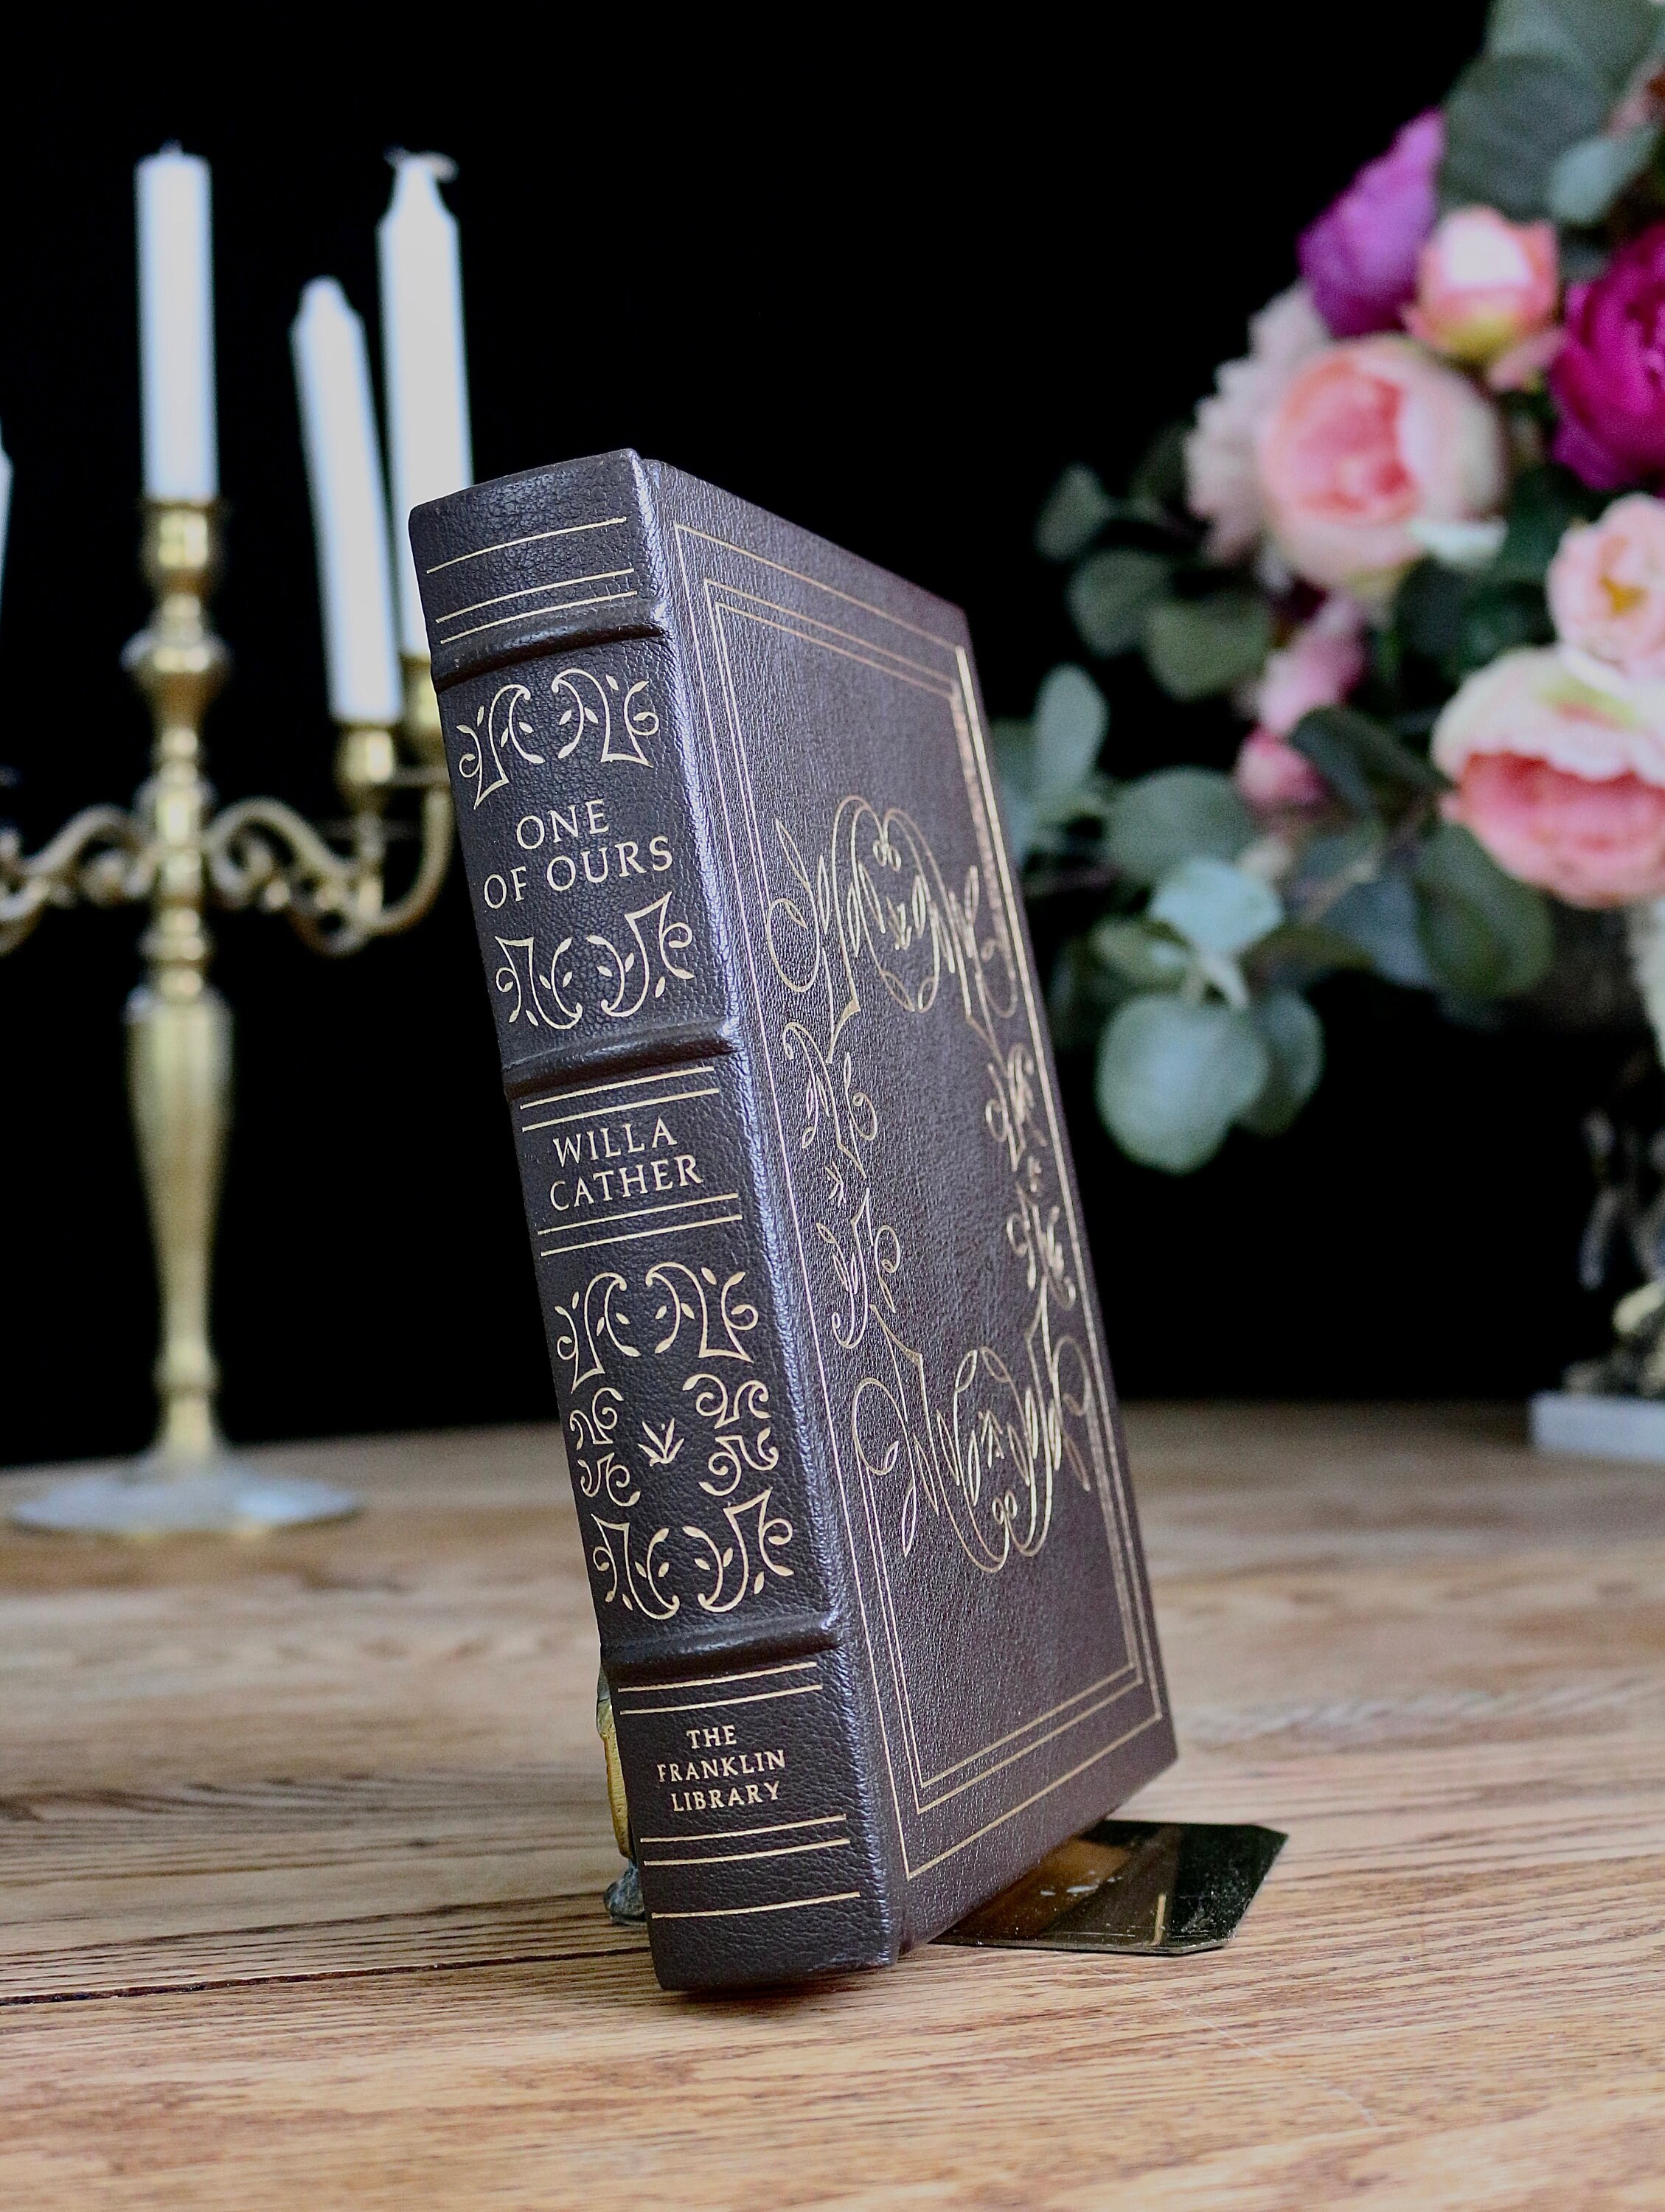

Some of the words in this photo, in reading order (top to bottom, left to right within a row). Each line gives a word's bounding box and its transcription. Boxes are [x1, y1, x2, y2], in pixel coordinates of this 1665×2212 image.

[516, 799, 609, 850] ONE
[484, 866, 526, 909] OF
[546, 835, 672, 891] OURS
[553, 1117, 678, 1167] WILLA
[549, 1154, 703, 1211] CATHER
[686, 1724, 737, 1749] THE
[656, 1749, 786, 1783] FRANKLIN
[671, 1780, 779, 1812] LIBRARY
